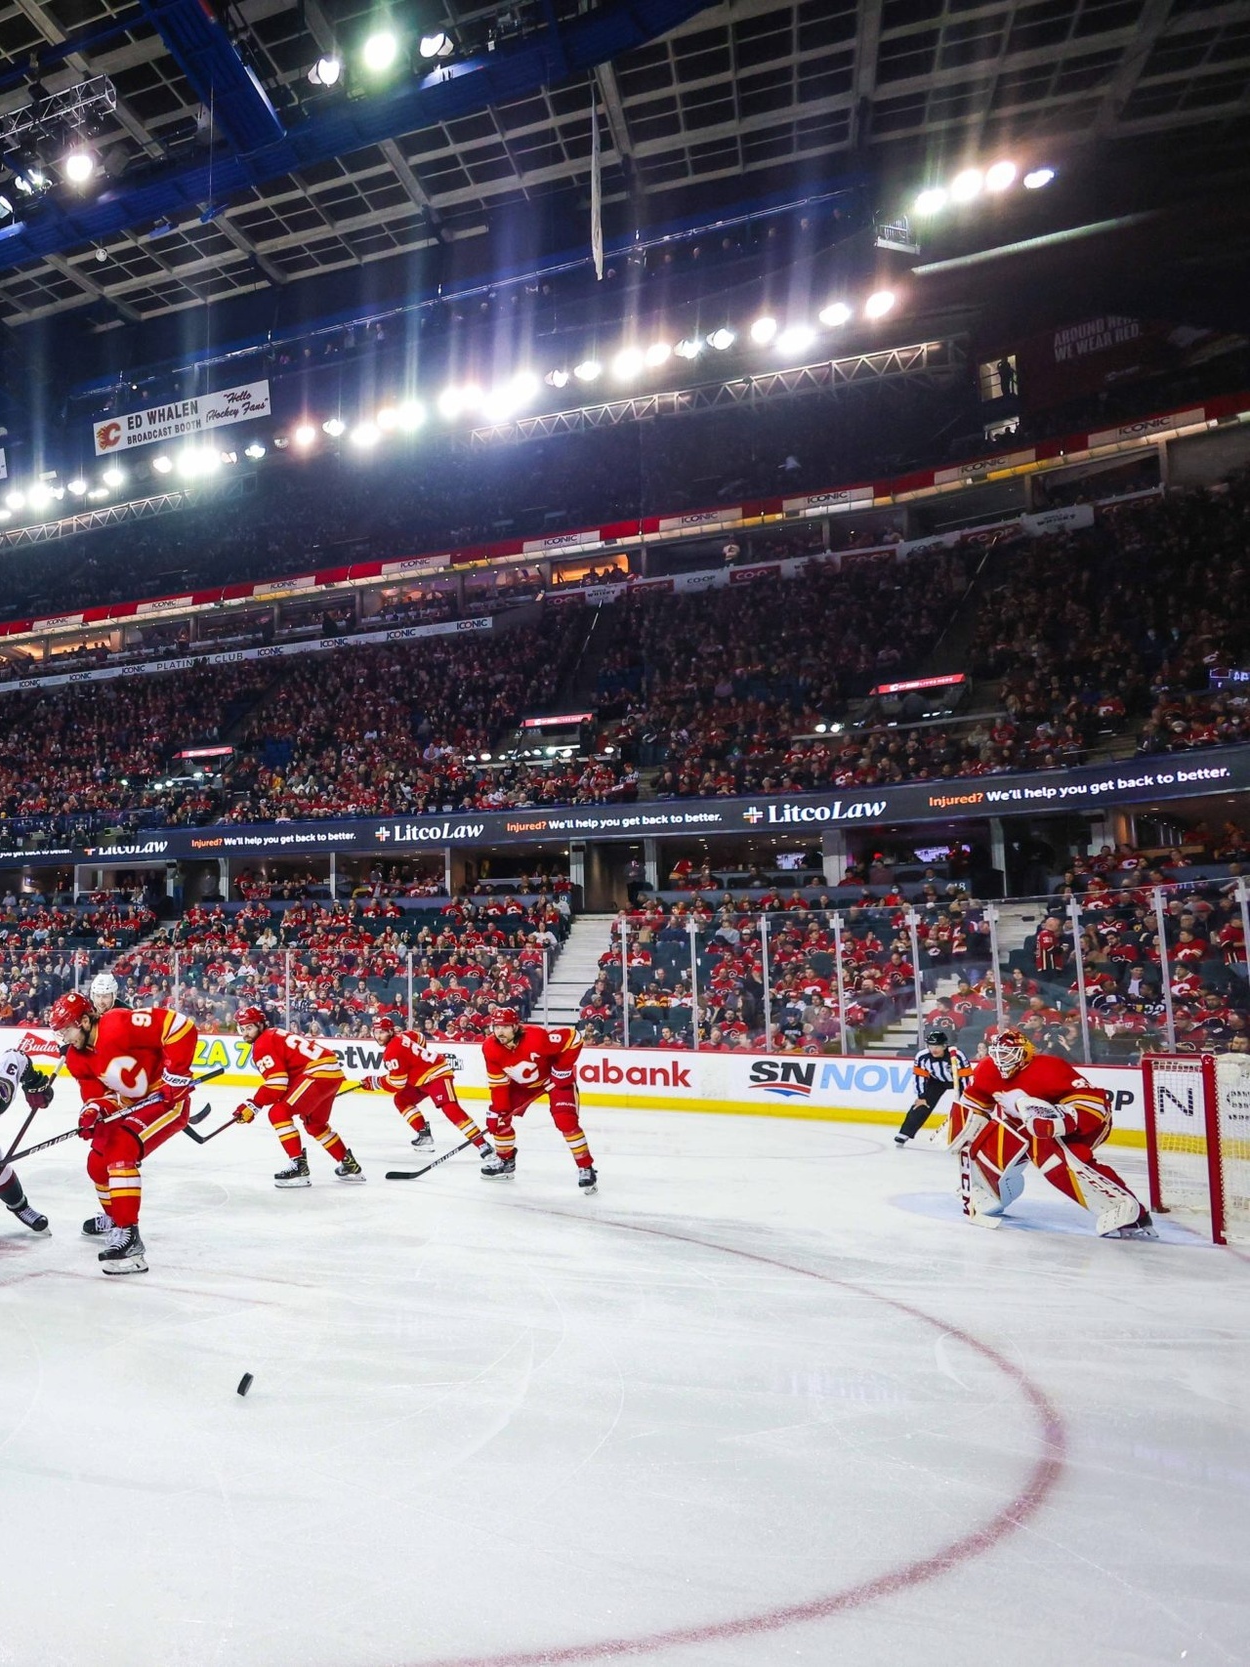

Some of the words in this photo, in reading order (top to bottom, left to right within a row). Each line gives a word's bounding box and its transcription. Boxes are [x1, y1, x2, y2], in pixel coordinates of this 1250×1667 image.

[127, 414, 143, 431] ED
[146, 400, 199, 426] WHALEN
[127, 426, 172, 446] BROADCAST
[175, 419, 202, 434] BOOTH
[1119, 416, 1171, 437] ICONIC
[961, 455, 1007, 474] ICONIC
[806, 491, 848, 505] ICONIC
[681, 512, 719, 524] ICONIC
[543, 534, 578, 546] ICONIC
[400, 556, 430, 568] ICONIC
[270, 579, 297, 590] ICONIC
[456, 618, 488, 630] ICONIC
[386, 628, 416, 640] ICONIC
[320, 637, 349, 648] ICONIC
[215, 652, 244, 663] CLUB
[257, 646, 284, 657] ICONIC
[121, 664, 146, 675] ICONIC
[929, 793, 984, 808] Injured?
[986, 789, 1022, 802] We'll
[1024, 786, 1057, 799] help
[1059, 784, 1087, 798] you
[1089, 780, 1115, 795] get
[1117, 775, 1154, 789] back
[1156, 774, 1174, 784] to
[1177, 767, 1230, 782] better.
[768, 801, 887, 823] LitcoLaw
[506, 821, 547, 833] Injured?
[548, 820, 573, 830] We'll
[575, 818, 597, 830] help
[599, 818, 620, 829] you
[621, 816, 641, 828] get
[642, 815, 669, 825] back
[670, 814, 684, 824] to
[684, 812, 723, 823] better.
[394, 822, 485, 842] LitcoLaw
[191, 838, 223, 850] Injured?
[244, 835, 262, 847] help
[263, 836, 279, 846] you
[279, 835, 295, 845] get
[296, 833, 316, 843] back
[317, 834, 327, 842] to
[327, 832, 356, 841] better.
[750, 1060, 817, 1087] SN
[961, 1150, 971, 1217] CCM
